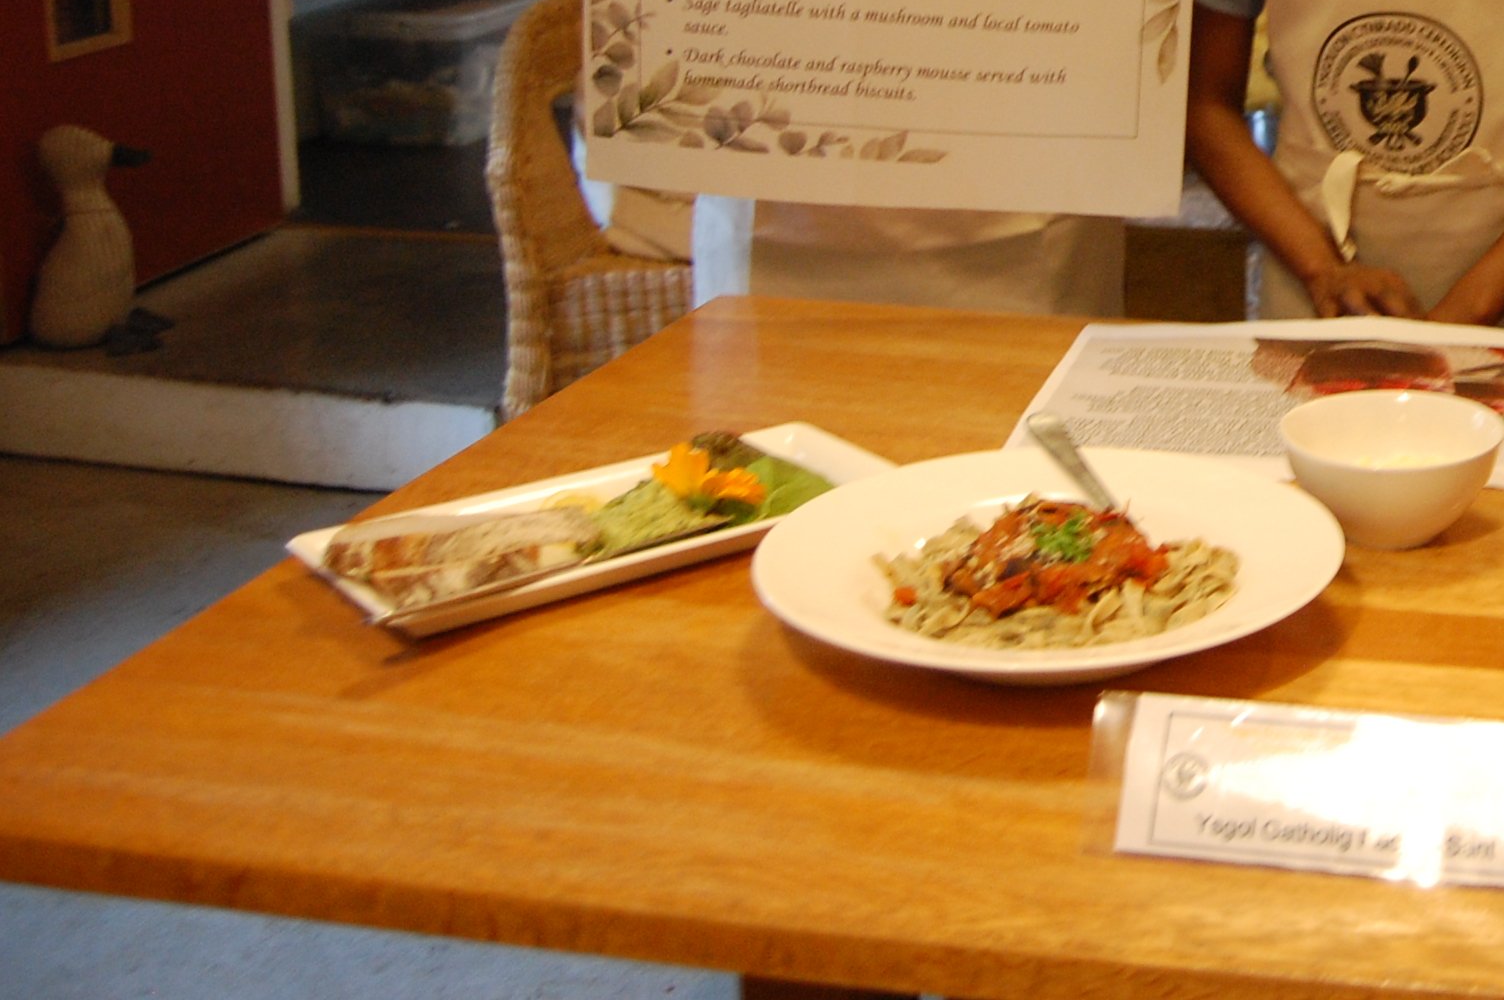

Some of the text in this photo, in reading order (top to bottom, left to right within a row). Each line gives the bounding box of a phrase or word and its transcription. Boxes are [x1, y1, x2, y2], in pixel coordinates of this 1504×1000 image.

[684, 22, 728, 35] sauce.
[809, 3, 846, 20] with
[849, 10, 861, 21] a
[864, 7, 944, 27] mushroom
[947, 13, 979, 29] and
[982, 14, 1023, 32] local
[1024, 20, 1081, 35] tomato
[684, 49, 1067, 84] Dark chocolate and raspberry mousse served with
[684, 70, 916, 101] homemade shortbread biscuits.
[1196, 814, 1257, 841] Ysgol
[1262, 819, 1351, 852] Catholig
